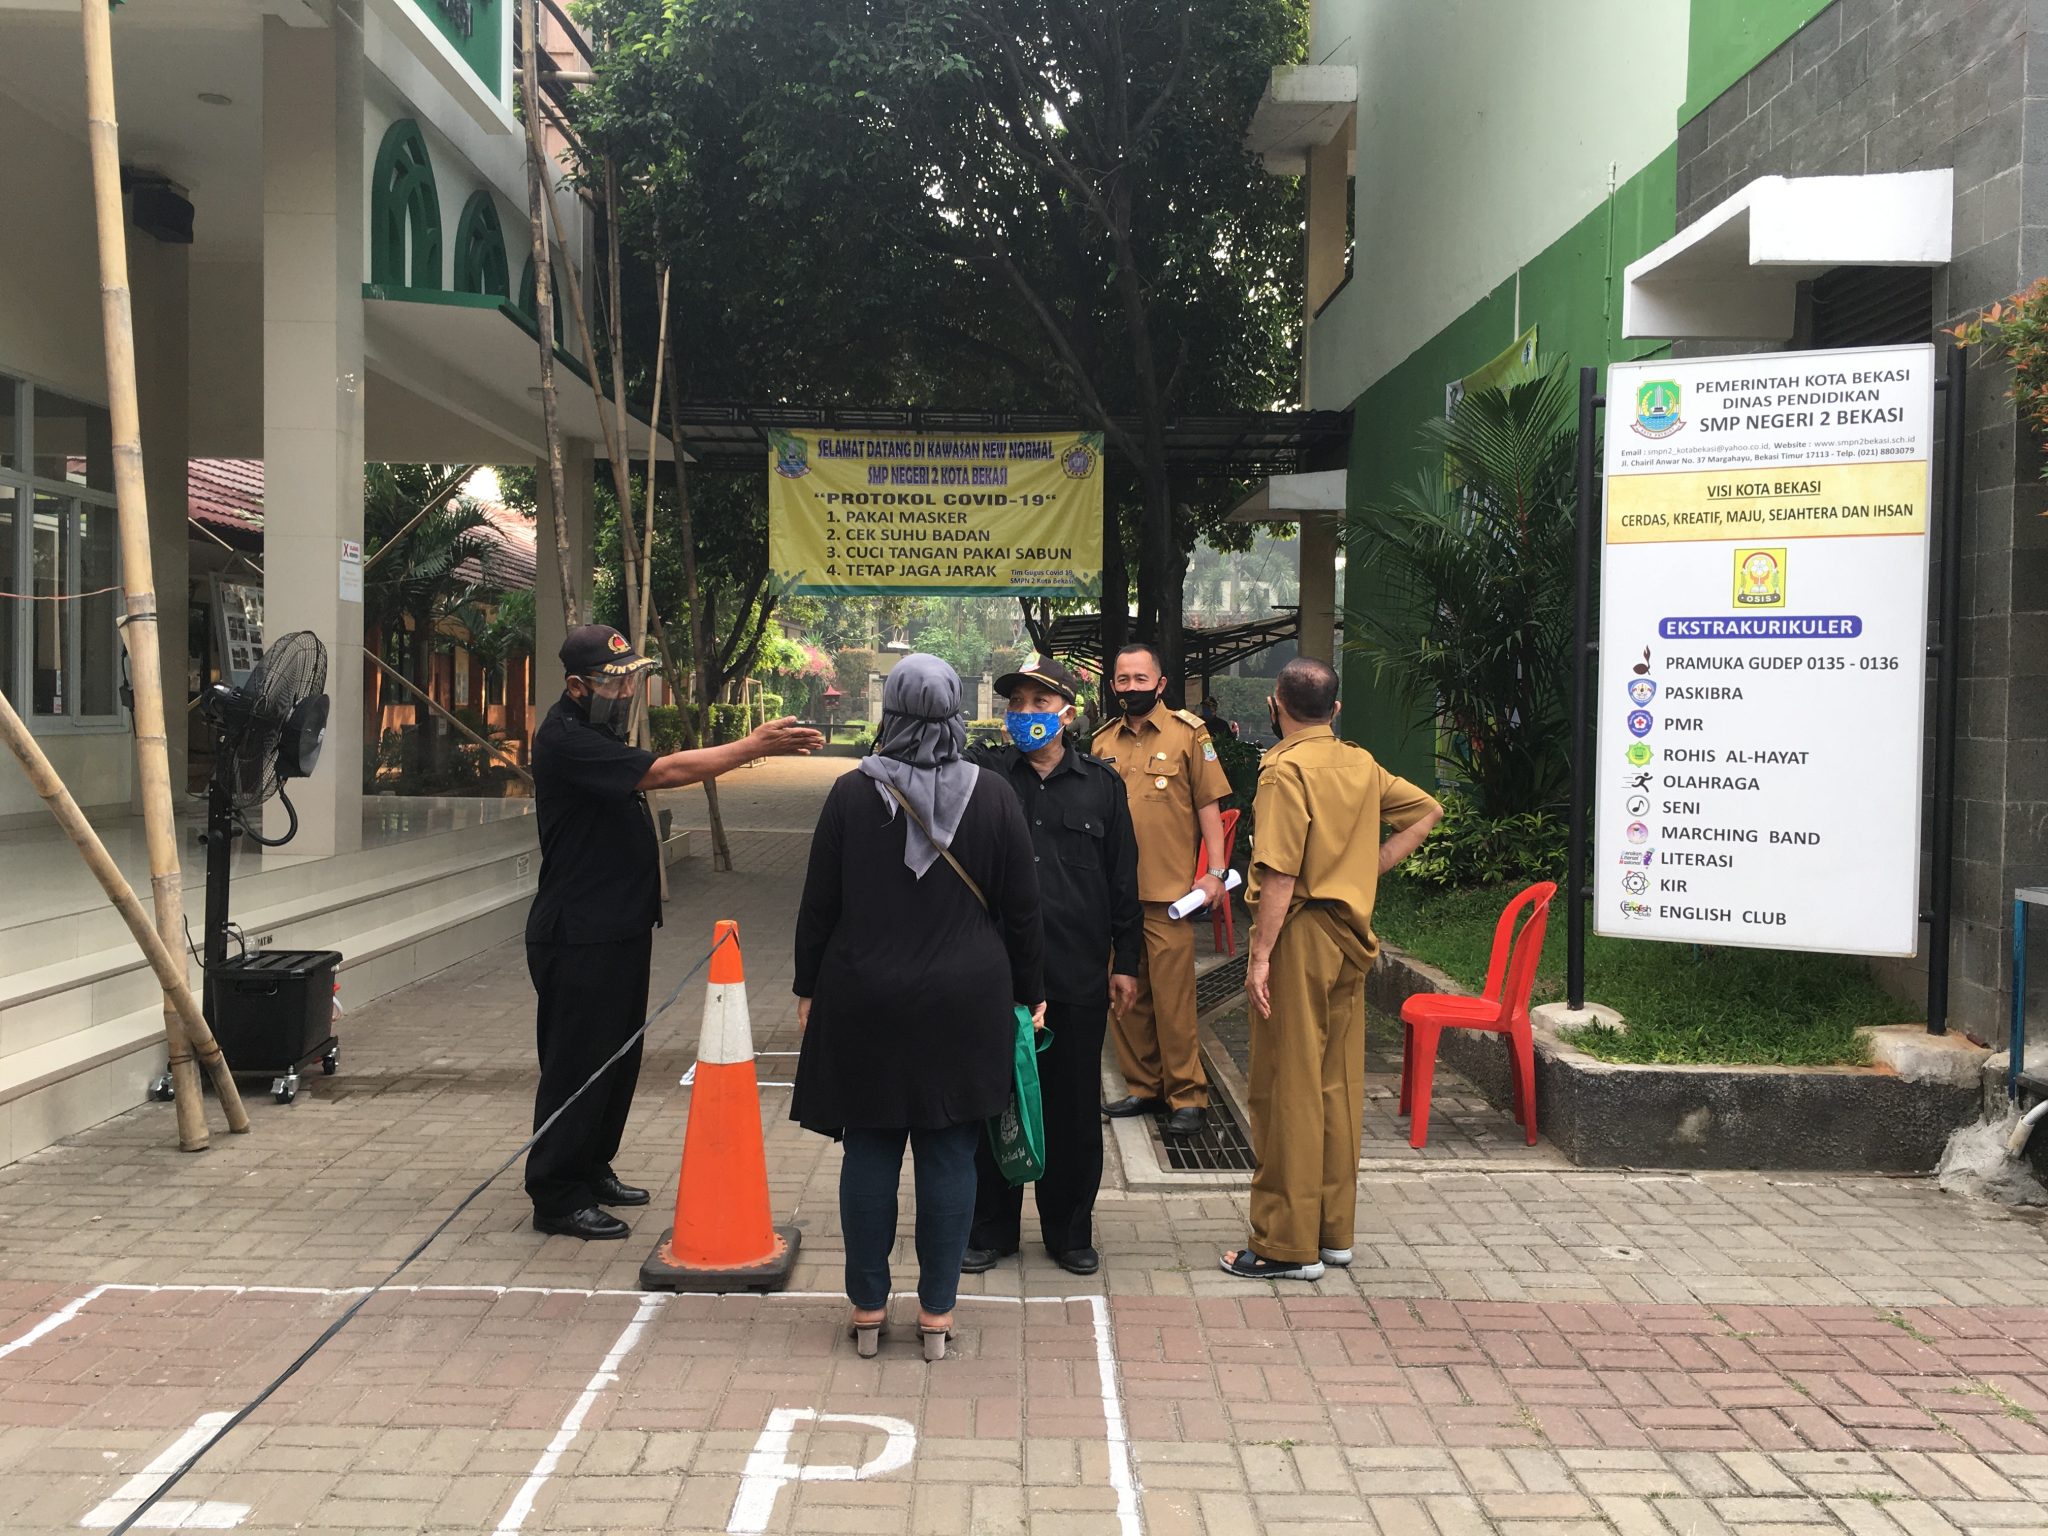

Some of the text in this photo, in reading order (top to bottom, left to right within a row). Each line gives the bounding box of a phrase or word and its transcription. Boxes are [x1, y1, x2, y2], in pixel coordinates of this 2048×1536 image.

[1696, 369, 1910, 393] PEMERINTAH KOTA BEKASI
[1723, 389, 1880, 409] DINAS PENDIDIKAN
[1699, 407, 1904, 432] SMP NEGERI 2 BEKASI
[817, 439, 1055, 460] SELAMAT DATANG DI KAWASAN NEW NORMAL
[1814, 436, 1916, 447] www.smpn2bekasi.sch.id
[1630, 458, 1654, 467] Chairil
[1656, 457, 1680, 465] Anwar
[1682, 456, 1695, 464] No.
[1707, 454, 1752, 464] Margahayu,
[1754, 453, 1779, 461] Bekasi
[1781, 452, 1803, 460] Timur
[1806, 450, 1830, 458] 17113
[1836, 449, 1855, 458] Telp.
[1858, 447, 1879, 457] (021)
[1880, 447, 1915, 455] 8803079
[868, 466, 1008, 486] SMP NEGERI 2 KOTA BEKASI
[1707, 481, 1821, 498] VISI KOTA BEKASI
[827, 511, 967, 524] 1. PAKAI MASKER
[1621, 504, 1913, 528] CERDAS, KREATIF, MAJU, SEJAHTERA DAN IHSAN
[827, 529, 990, 542] 2. CEK SUHU BADAN
[827, 546, 1072, 560] 3. CUCI TANGAN PAKAI SABUN
[826, 564, 996, 579] 4. TETAP JAGA JARAK
[1024, 570, 1044, 578] Gugus
[1666, 620, 1853, 635] EKSTRAKURIKULER
[1665, 656, 1744, 670] PRAMUKA
[1749, 656, 1802, 670] GUDEP
[1807, 656, 1845, 670] 0135
[1860, 656, 1899, 670] 0136
[1665, 687, 1743, 700] PASKIBRA
[1664, 718, 1704, 731] PMR
[1663, 749, 1809, 765] ROHIS AL-HAYAT
[1663, 775, 1760, 791] OLAHRAGA
[1662, 801, 1700, 815] SENI
[1661, 826, 1821, 845] MARCHING BAND
[1661, 852, 1733, 868] LITERASI
[1660, 879, 1687, 893] KIR
[1660, 906, 1787, 926] ENGLISH CLUB
[80, 1408, 917, 1535] L P
